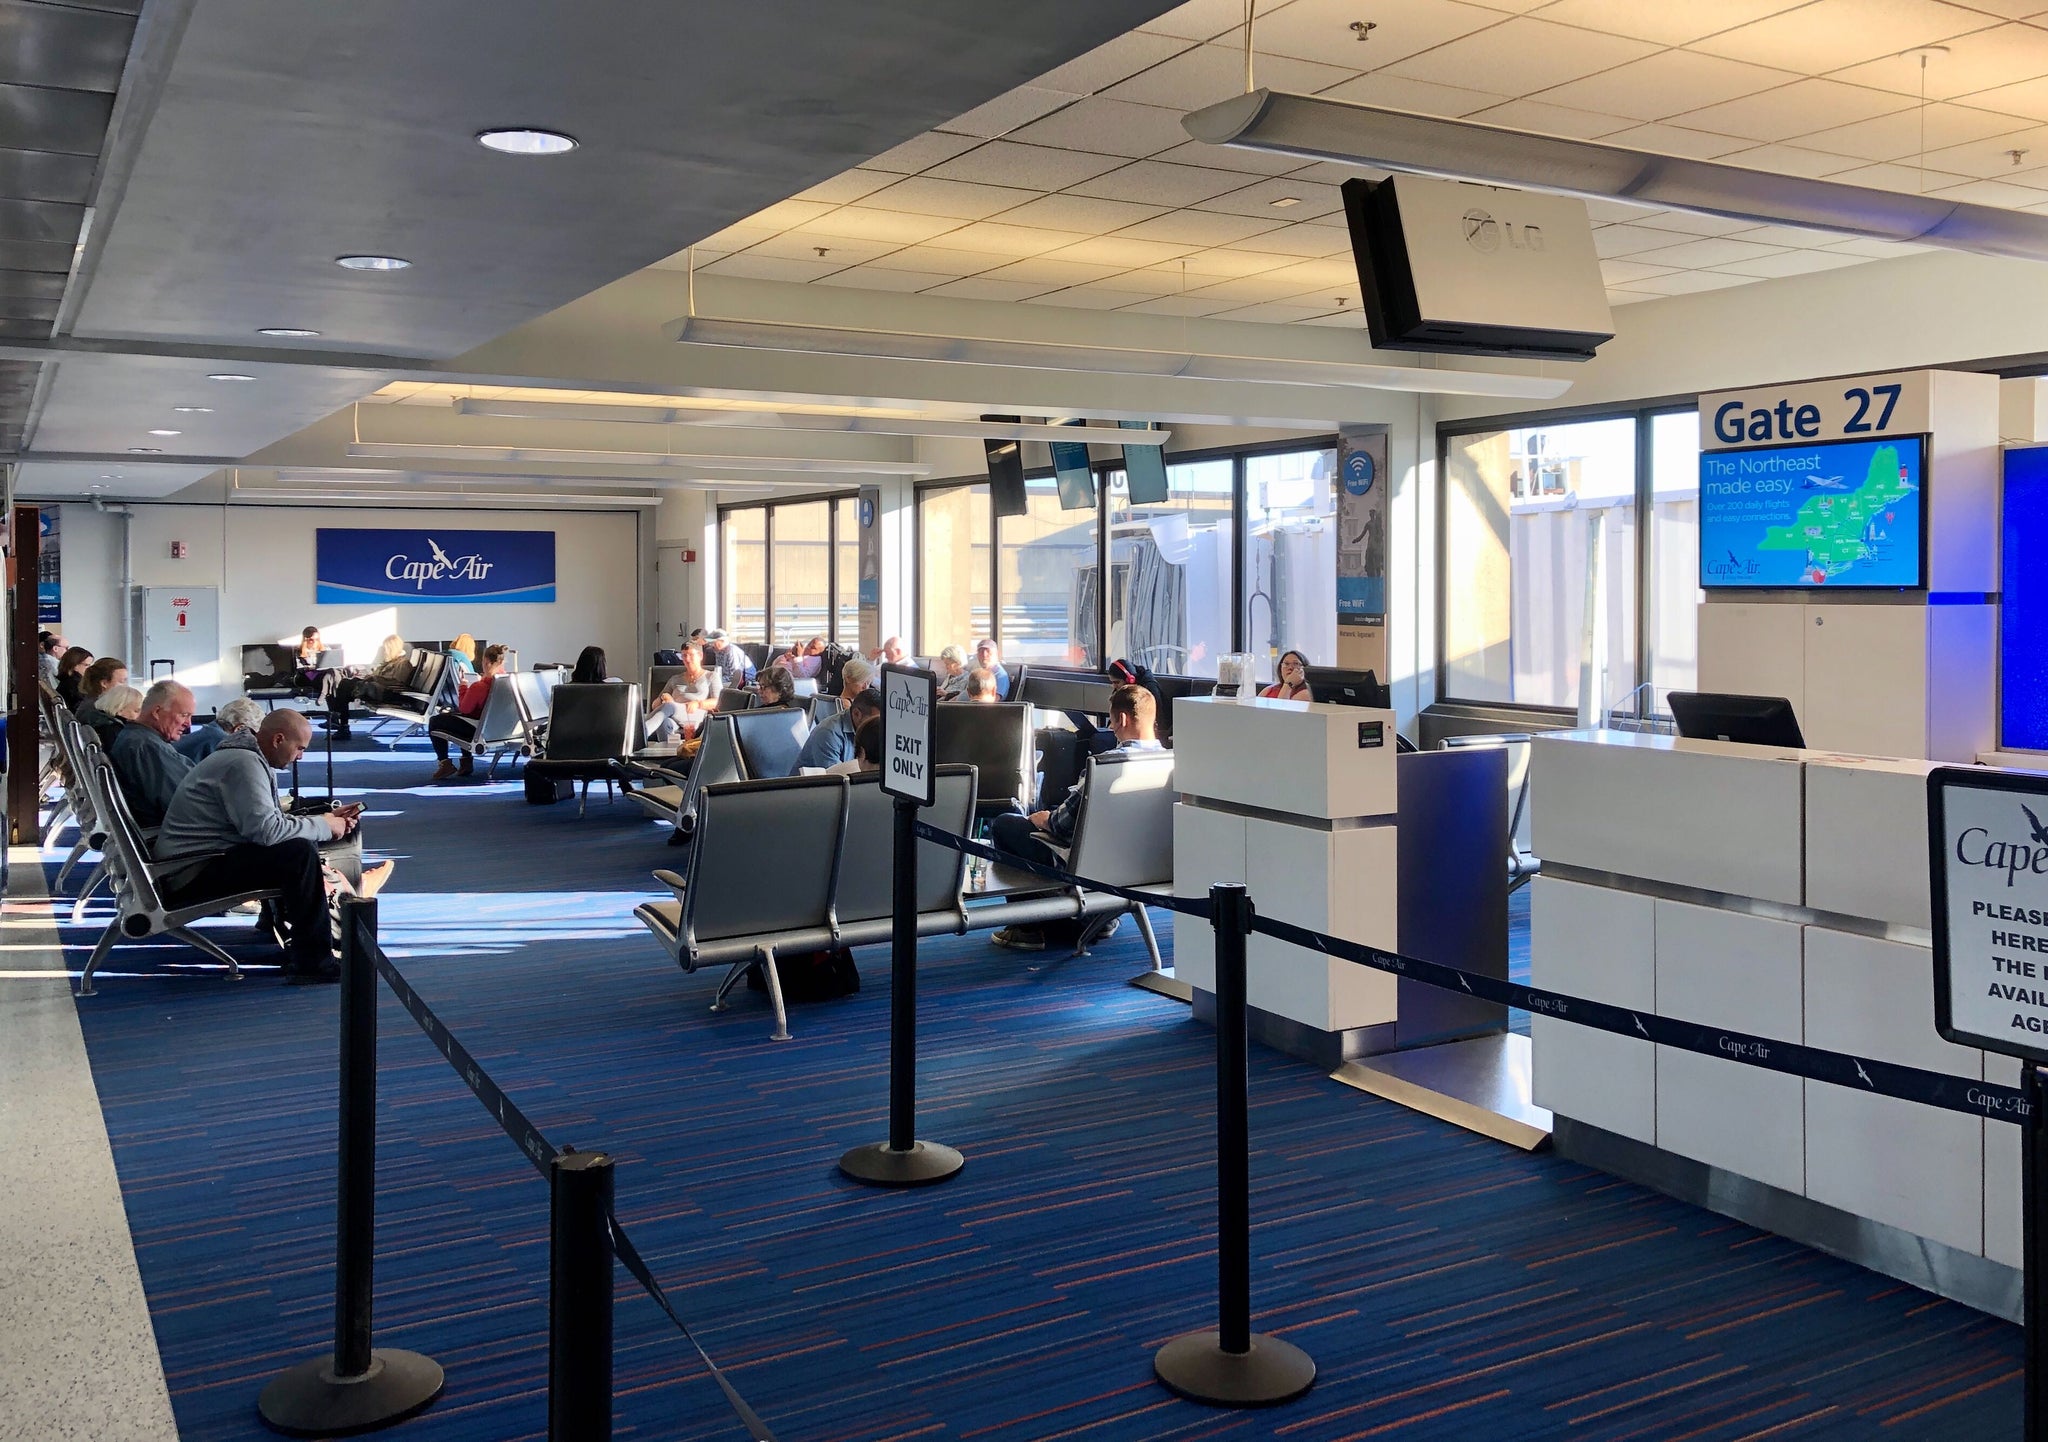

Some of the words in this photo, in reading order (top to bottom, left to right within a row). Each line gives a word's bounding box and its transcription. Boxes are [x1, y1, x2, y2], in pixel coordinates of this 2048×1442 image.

[1505, 222, 1545, 251] LG
[1714, 399, 1821, 443] Gate
[1843, 384, 1902, 433] 27
[1707, 460, 1736, 476] The
[1740, 454, 1821, 474] Northeast
[1707, 478, 1751, 495] made
[1755, 478, 1794, 494] easy.
[1727, 501, 1744, 510] 200
[1744, 501, 1764, 510] daily
[1764, 499, 1790, 509] flights
[385, 554, 446, 590] Cape
[448, 553, 494, 580] Air
[1707, 559, 1735, 580] Cape
[1339, 599, 1351, 607] Free
[889, 690, 910, 719] Cape
[895, 734, 922, 756] EXIT
[893, 756, 924, 780] ONLY
[1956, 827, 2048, 887] Cape
[1991, 930, 2048, 954] HERE
[1372, 953, 1391, 969] Cape
[1391, 958, 1406, 970] Air
[1991, 956, 2036, 978] THE
[1527, 993, 1550, 1012] Cape
[1550, 999, 1569, 1013] Air
[1719, 1035, 1747, 1058] Cape
[1748, 1042, 1771, 1059] Air
[1967, 1087, 2003, 1114] Cape
[2004, 1096, 2034, 1115] Air
